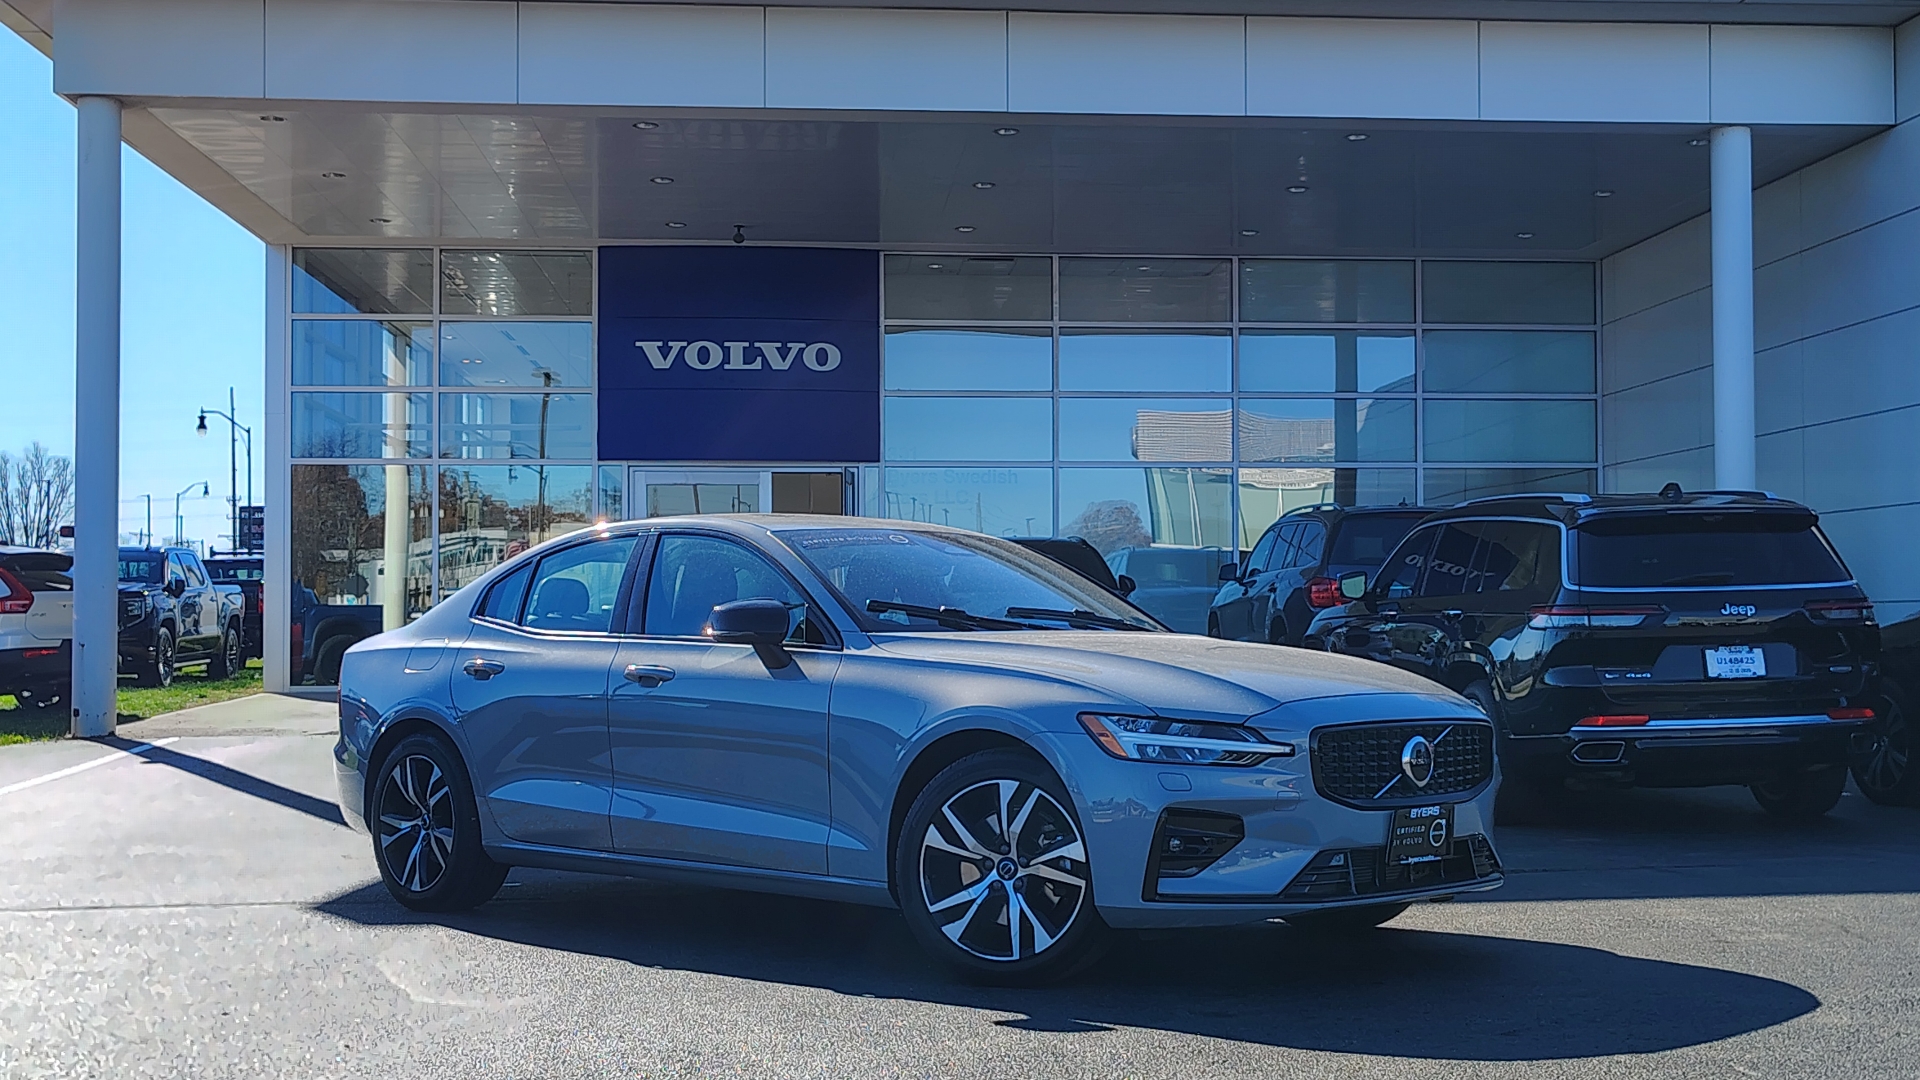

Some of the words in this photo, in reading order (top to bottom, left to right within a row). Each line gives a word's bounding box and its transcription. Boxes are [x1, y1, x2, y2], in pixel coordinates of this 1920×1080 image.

[634, 340, 842, 372] VOLVO
[943, 469, 1018, 484] Swedish
[1721, 603, 1756, 617] Jeep
[1716, 657, 1756, 665] U148425
[1410, 806, 1441, 819] BYERS
